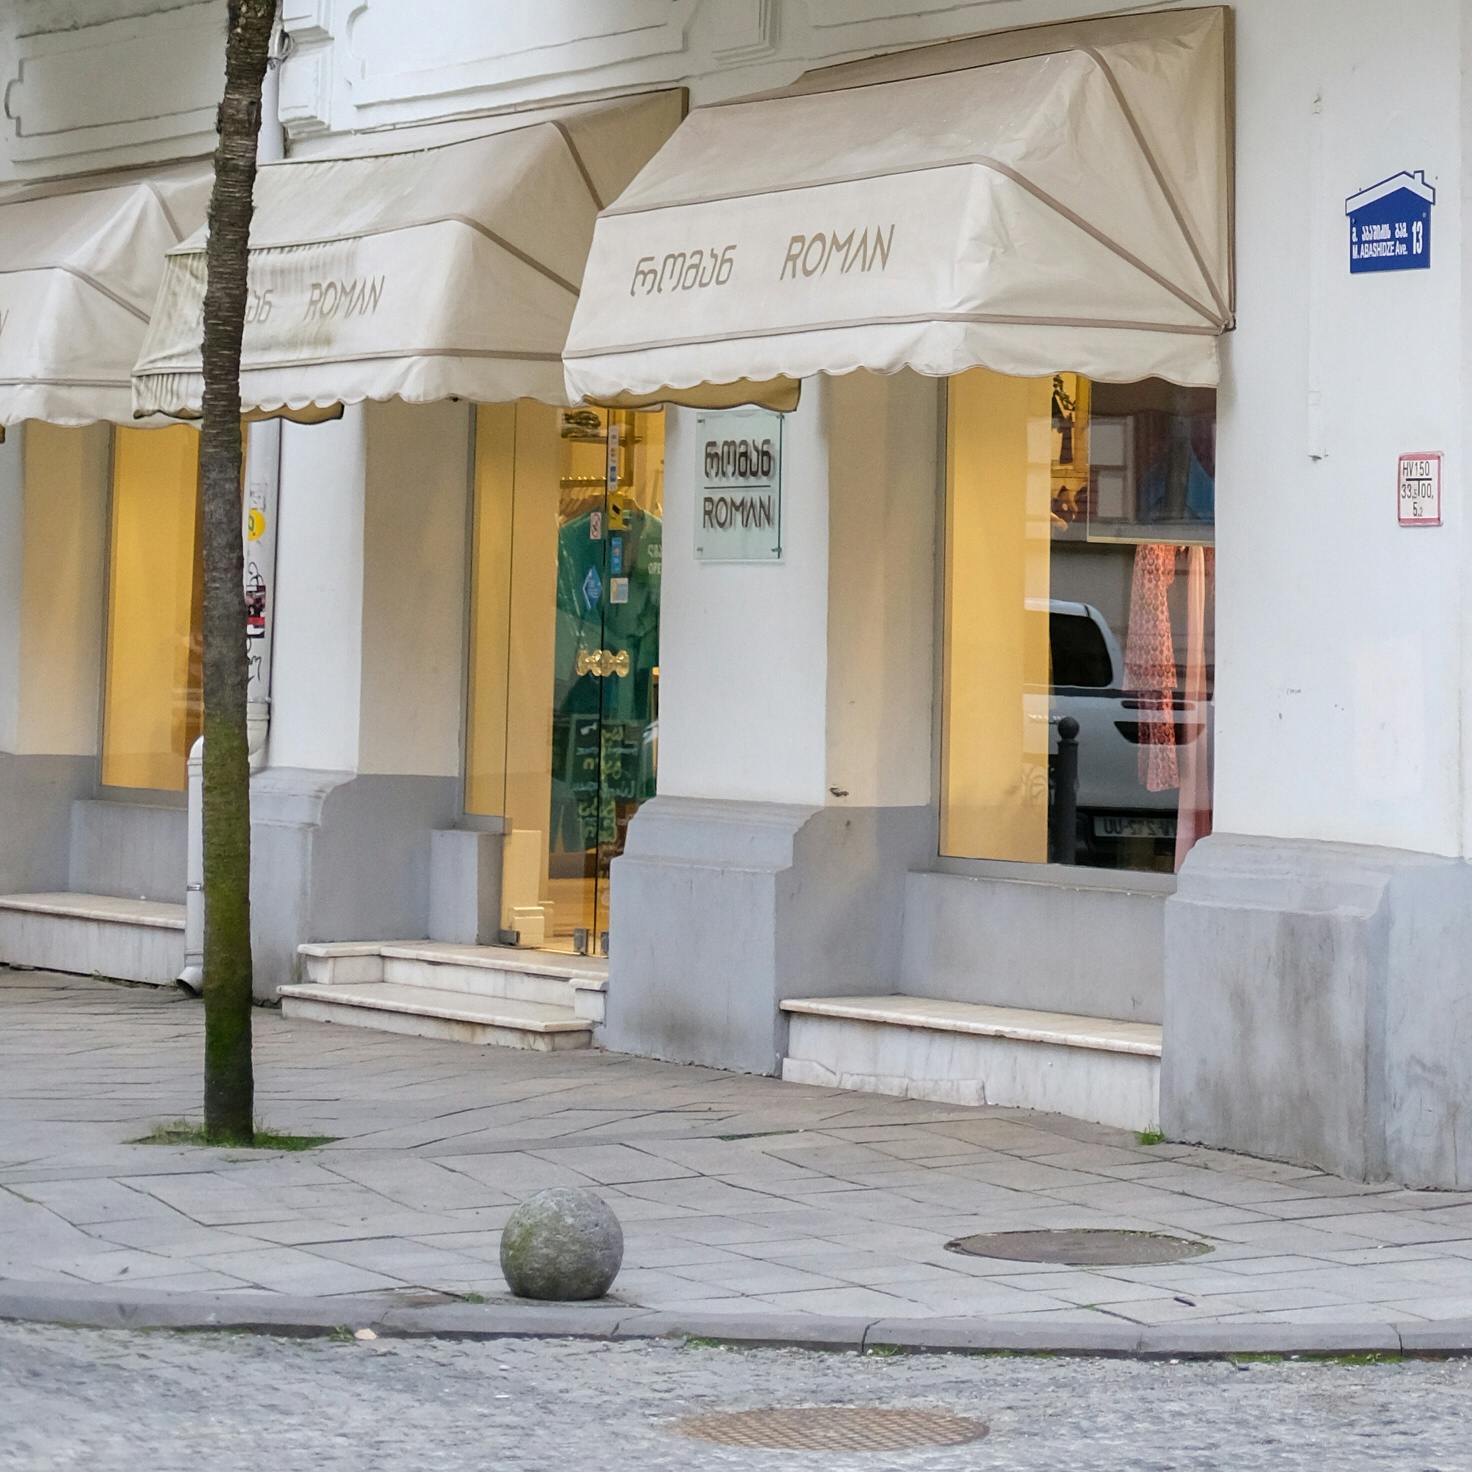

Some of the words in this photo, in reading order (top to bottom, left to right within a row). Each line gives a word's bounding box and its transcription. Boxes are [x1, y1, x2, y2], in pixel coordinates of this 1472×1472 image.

[779, 223, 895, 281] ROMAN
[1360, 241, 1395, 259] ABASHIDZE
[1395, 240, 1408, 256] Ave.
[1412, 221, 1423, 255] 13
[630, 244, 737, 297] რომან
[304, 275, 385, 321] ROMAN
[704, 439, 772, 478] რომან
[1402, 461, 1430, 477] HV150
[703, 495, 771, 529] ROMAN
